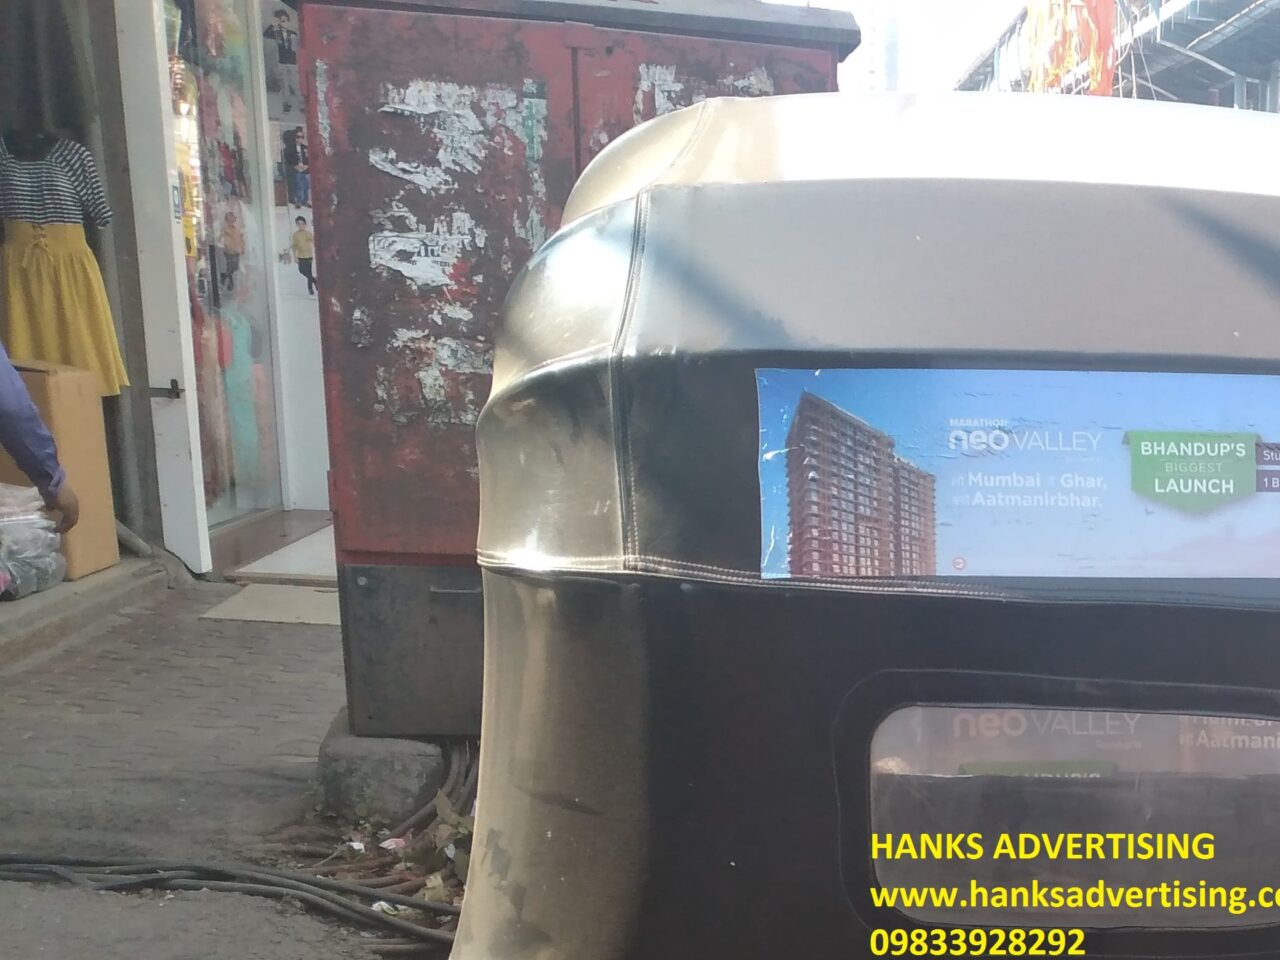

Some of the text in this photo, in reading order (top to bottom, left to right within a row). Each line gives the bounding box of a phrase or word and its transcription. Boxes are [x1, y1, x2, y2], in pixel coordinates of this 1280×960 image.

[949, 418, 1008, 427] MARATHON
[1141, 441, 1246, 457] BHANDUP'S
[1165, 462, 1223, 473] BIGGEST
[967, 472, 1041, 487] Mumbai
[1060, 473, 1107, 490] Ghar,
[1154, 477, 1234, 493] LAUNCH
